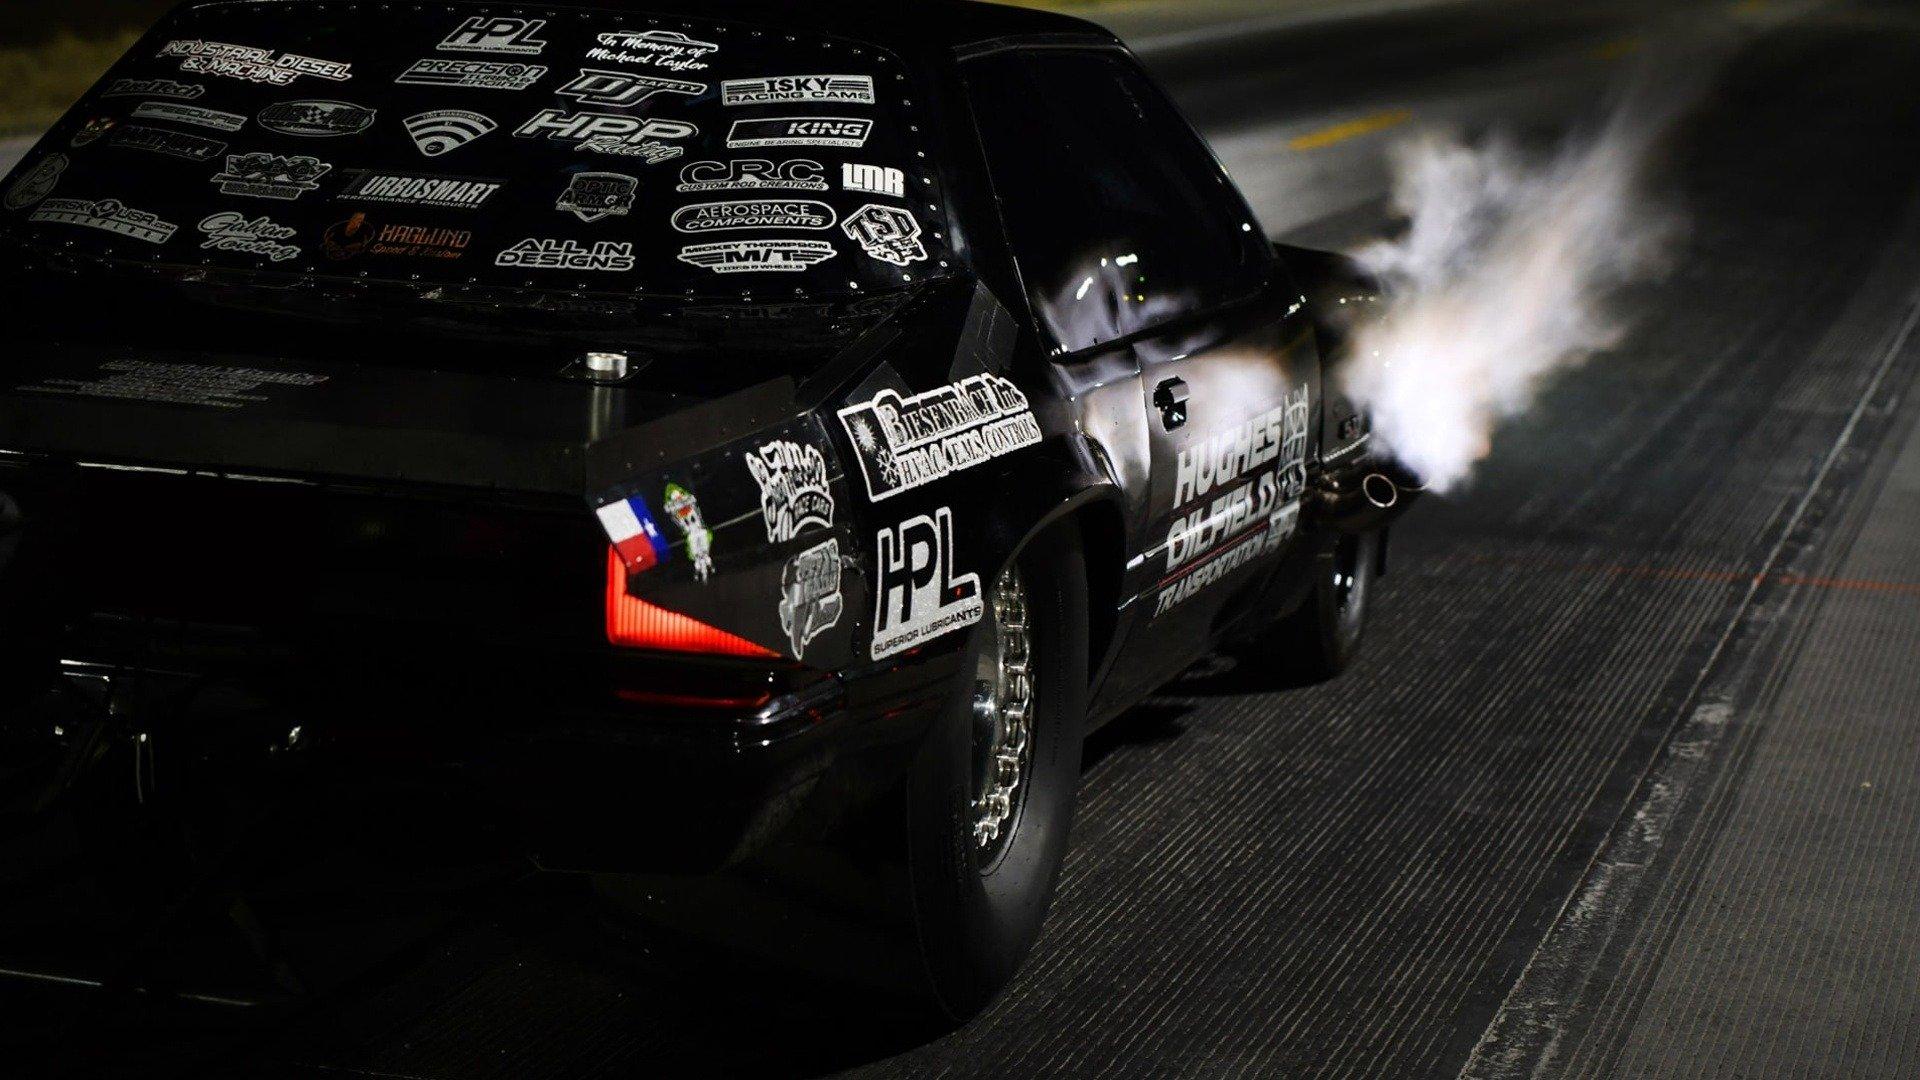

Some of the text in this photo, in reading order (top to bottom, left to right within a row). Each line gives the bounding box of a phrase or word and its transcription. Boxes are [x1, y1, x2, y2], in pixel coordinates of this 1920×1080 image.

[443, 18, 547, 47] HPL
[621, 37, 685, 56] Memory
[687, 47, 708, 58] of
[156, 41, 352, 82] INDUSTRIAL DIESEL
[586, 48, 709, 71] Michael Taylor
[206, 57, 300, 86] MACHINE
[636, 79, 701, 92] SAFETY
[726, 90, 871, 103] RACING CAMS
[765, 79, 830, 92] ISKY
[512, 110, 699, 143] HPP
[787, 122, 864, 136] KING
[575, 135, 683, 163] Racing
[680, 159, 824, 184] CRC
[842, 163, 904, 195] LMR
[680, 180, 824, 190] CUSTOM ROD CREATIONS
[336, 193, 480, 210] PERFORMANCE PRODUCTS
[696, 204, 812, 219] AEROSPACE
[685, 217, 824, 230] COMPONENTS
[378, 224, 472, 249] HAGLUND
[504, 240, 634, 257] ALL IN
[684, 242, 828, 255] MICKEY THOMPSON
[724, 248, 799, 263] M/T
[497, 252, 635, 269] DESIGNS
[984, 417, 1040, 454] CONTROLS
[1173, 406, 1283, 511] HUGHES
[1165, 470, 1277, 573] OILFIELD
[877, 513, 979, 633] HPL
[873, 605, 982, 655] SUPERIOR LUBRICANTS
